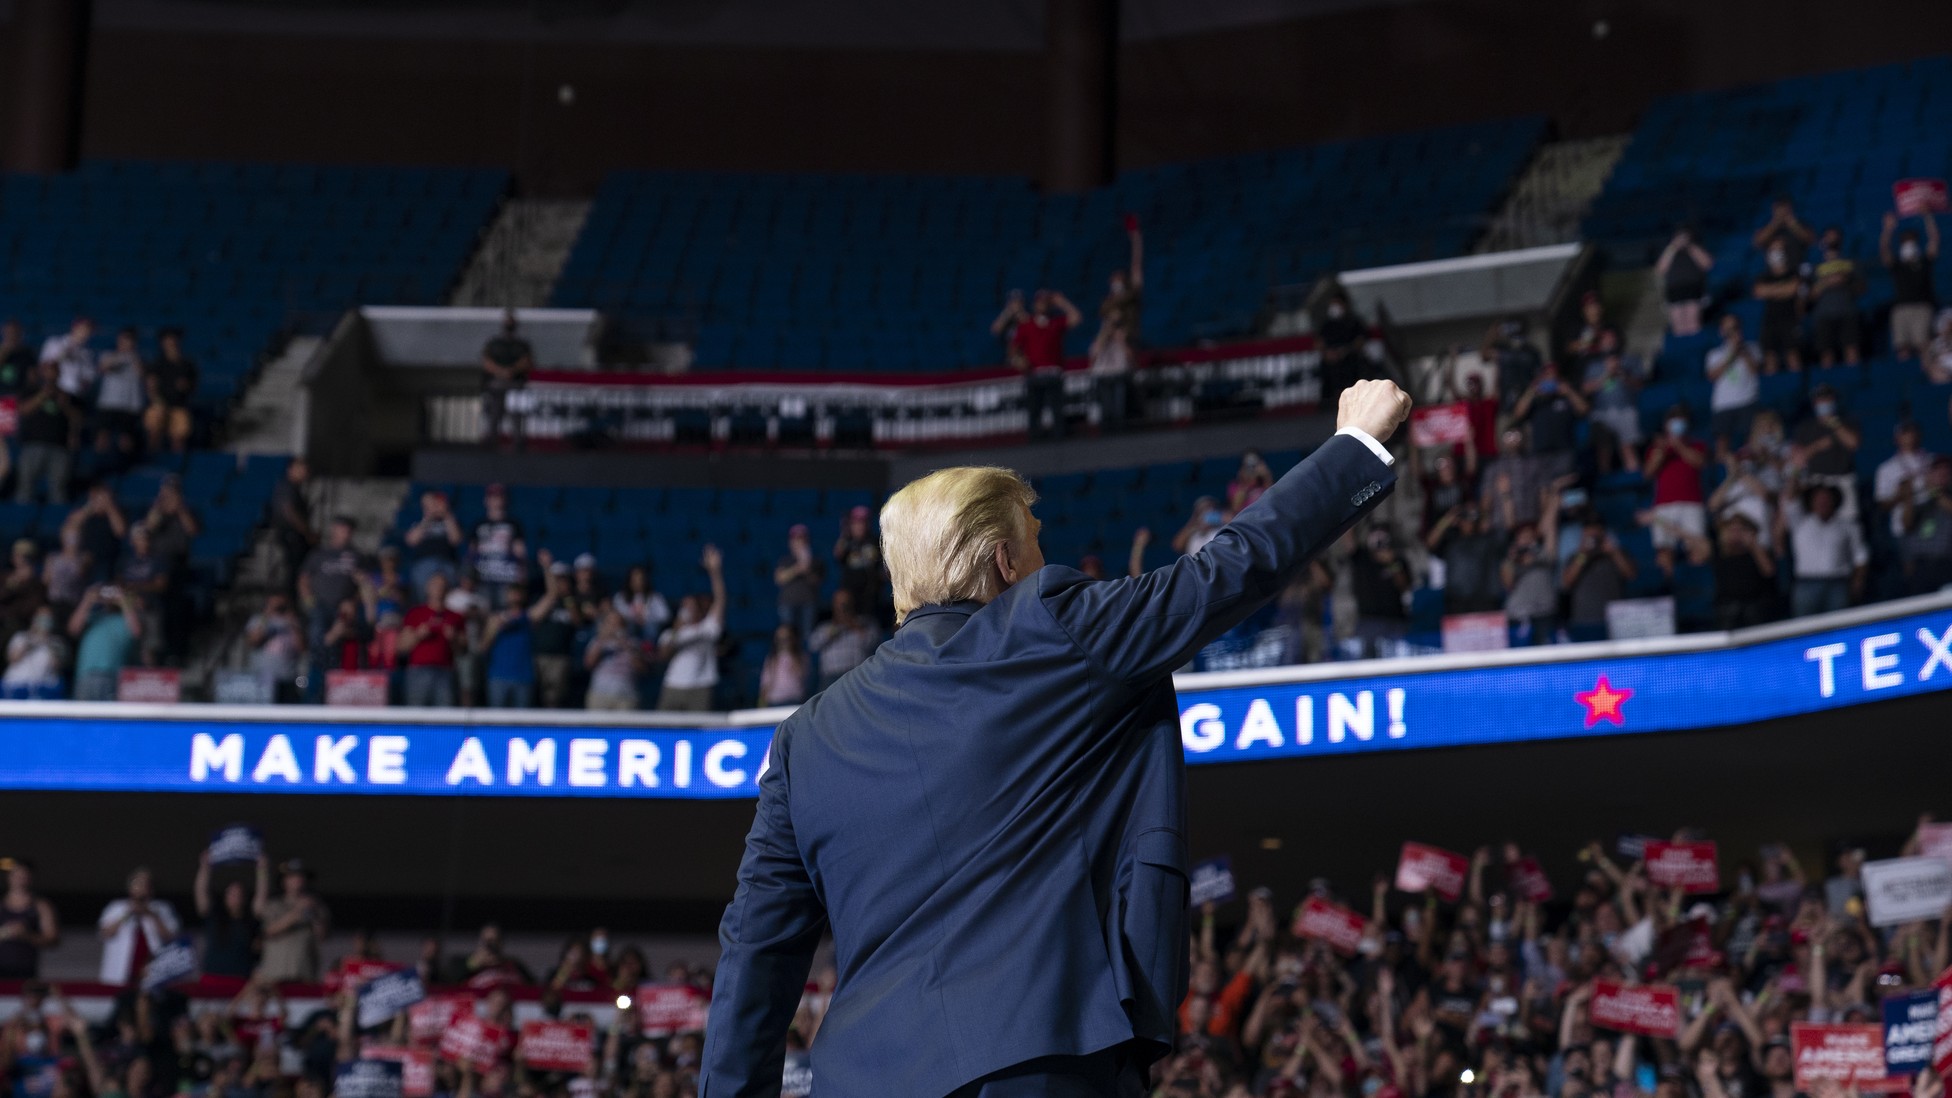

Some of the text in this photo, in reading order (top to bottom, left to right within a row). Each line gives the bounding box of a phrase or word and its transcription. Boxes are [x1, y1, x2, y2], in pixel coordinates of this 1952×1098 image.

[189, 687, 1407, 788] MAKE AMERIC GAIN!
